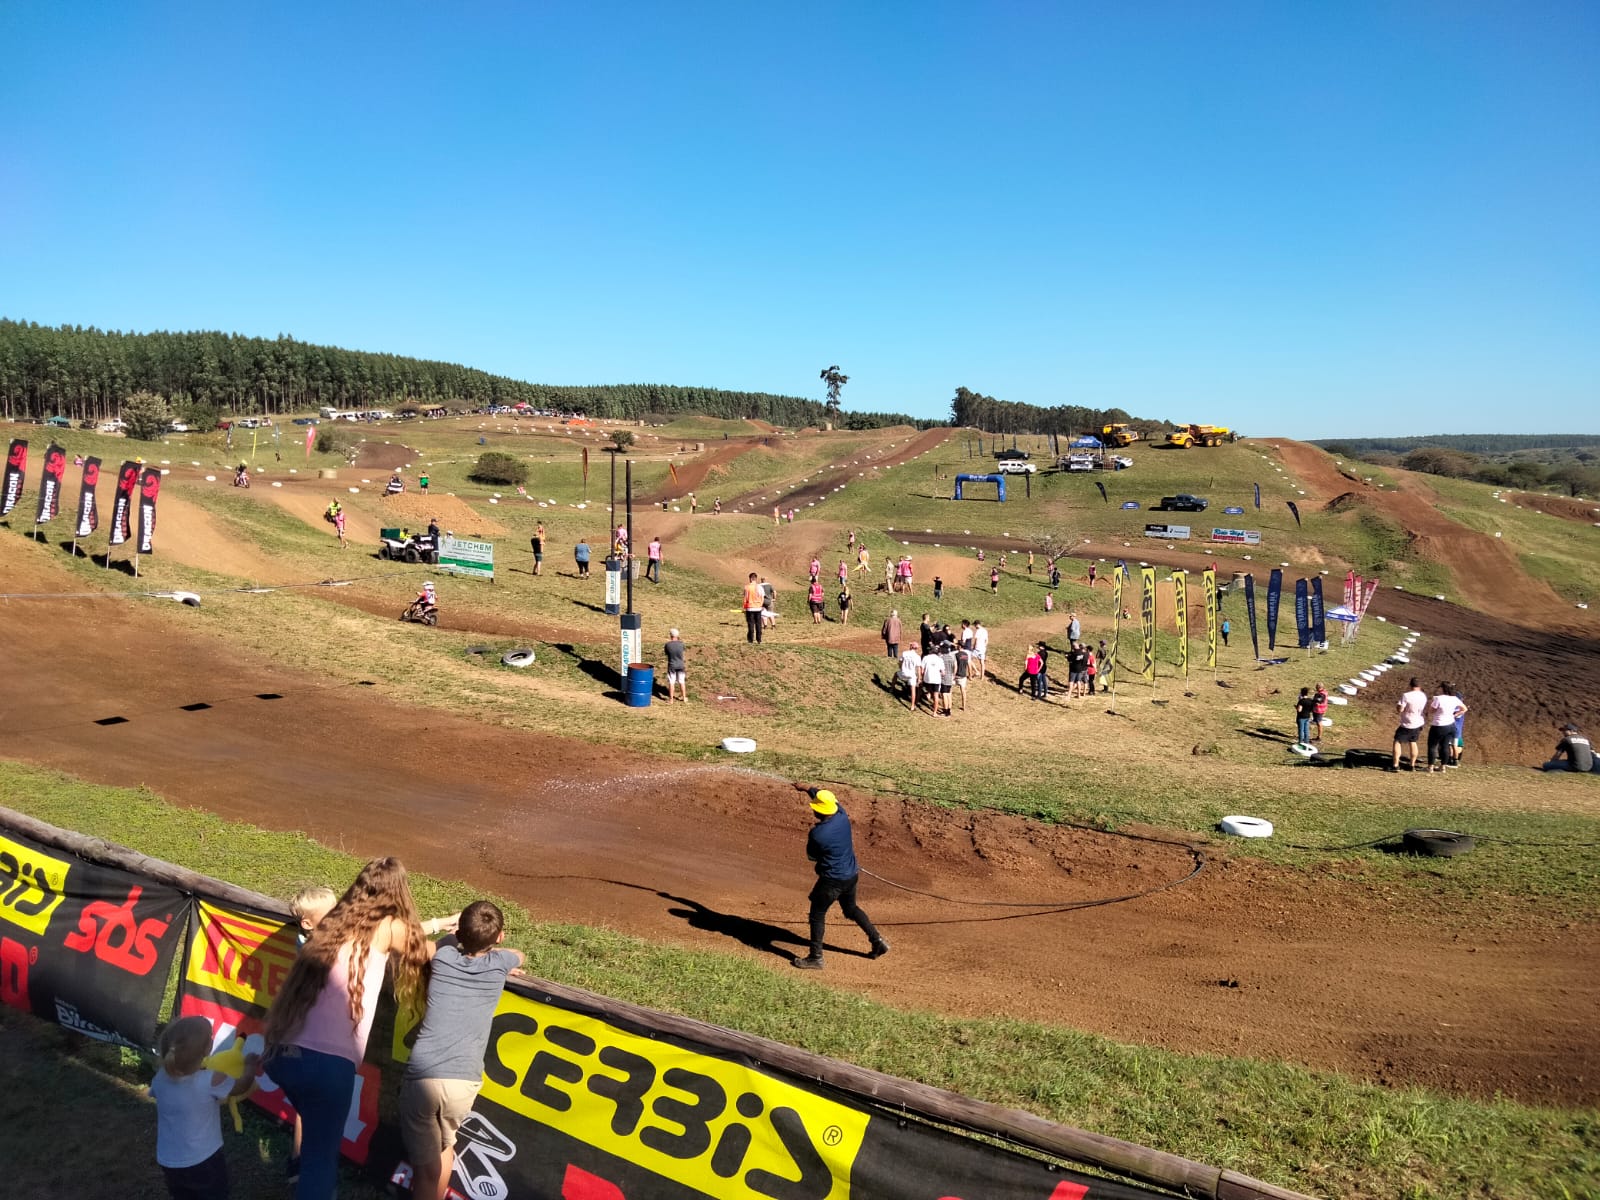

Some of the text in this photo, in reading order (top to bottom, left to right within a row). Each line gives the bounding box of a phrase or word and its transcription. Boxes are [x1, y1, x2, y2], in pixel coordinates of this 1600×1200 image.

[3, 473, 19, 514] DRAGON
[40, 480, 55, 522] DRAGON
[80, 491, 93, 536] DRAGON
[113, 498, 126, 543] DRAGON
[142, 505, 153, 550] DRAGON
[452, 541, 492, 551] JETCHEM
